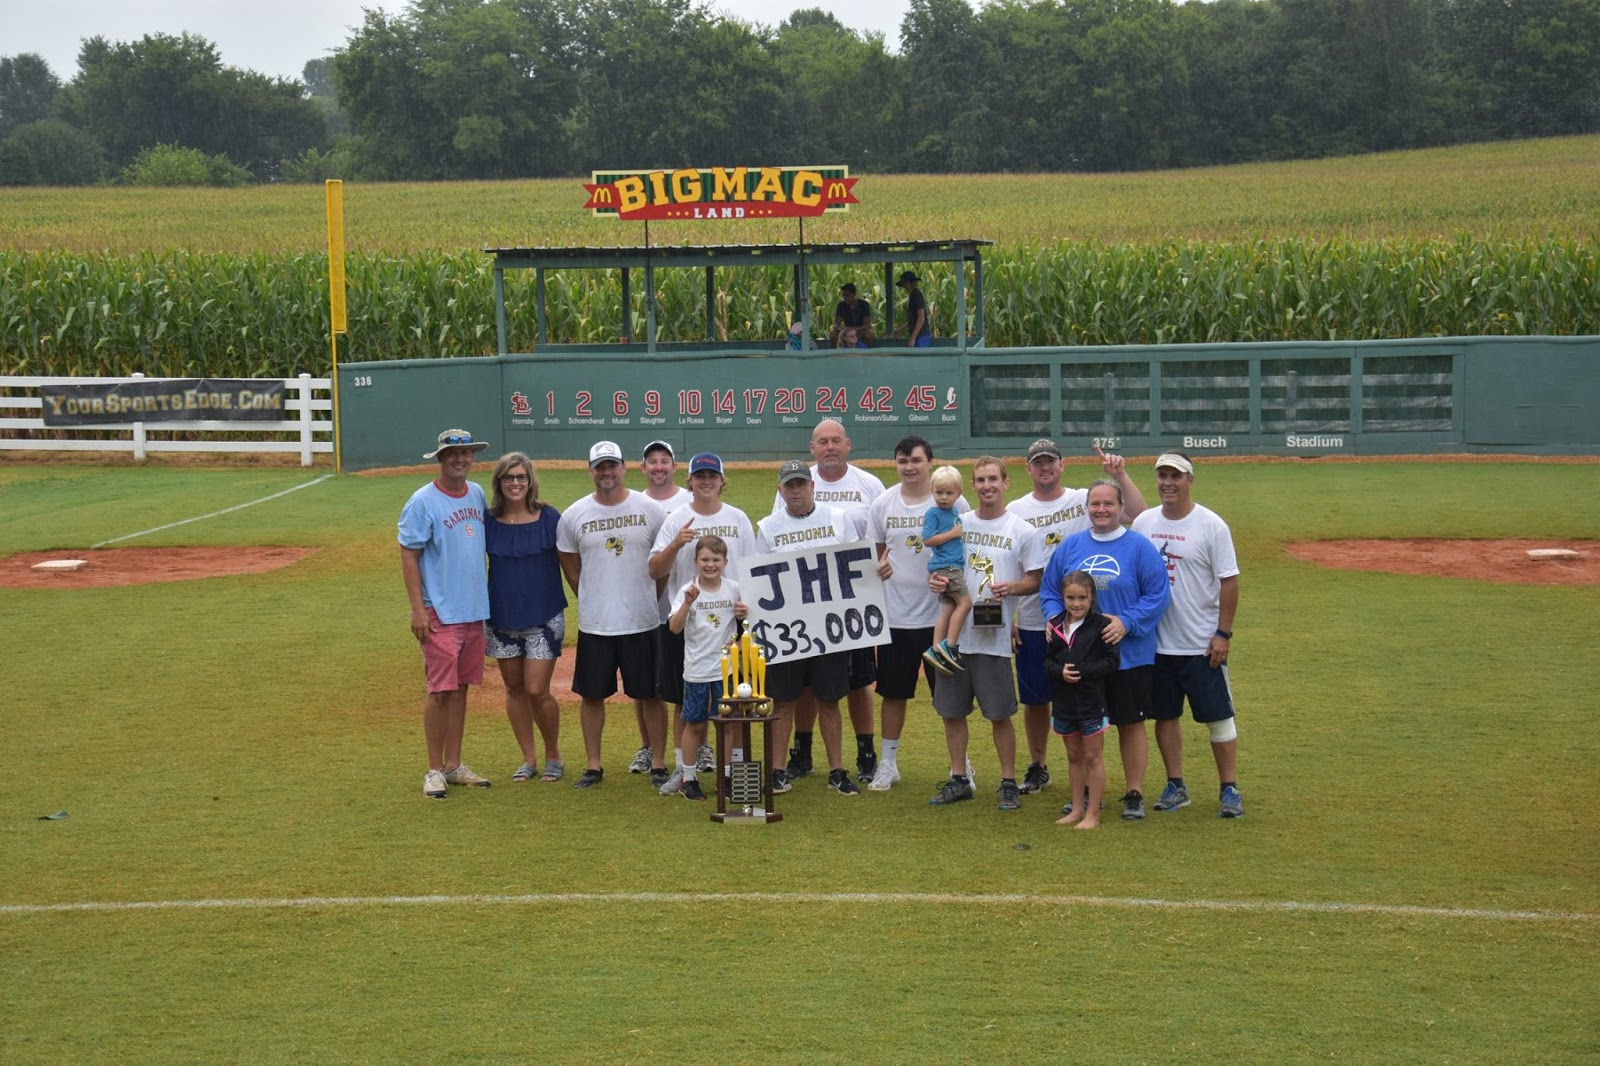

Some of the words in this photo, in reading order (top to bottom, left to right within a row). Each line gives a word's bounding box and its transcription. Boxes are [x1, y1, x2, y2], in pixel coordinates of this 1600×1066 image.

[614, 168, 702, 213] BIG
[712, 166, 824, 207] MAC
[694, 207, 745, 218] LAND
[354, 376, 372, 386] 336
[546, 391, 555, 415] 1
[576, 391, 592, 416] 2
[613, 391, 629, 416] 6
[645, 390, 661, 416] 9
[678, 390, 701, 415] 10
[712, 389, 735, 415] 14
[743, 388, 768, 414] 17
[775, 387, 806, 414] 20
[815, 386, 848, 412] 24
[859, 386, 893, 412] 42
[904, 385, 936, 411] 45
[512, 417, 536, 426] Hornsby
[544, 417, 560, 425] Smith
[568, 417, 605, 425] Schoendienst
[612, 417, 630, 425] Musial
[640, 416, 666, 425] Slaughter
[678, 417, 686, 425] La
[687, 417, 704, 425] Russa
[716, 416, 733, 426] Boyer
[746, 417, 762, 425] Dean
[855, 414, 899, 422] Robinson/Sutter
[909, 414, 929, 422] Gibson
[941, 414, 957, 422] Buck
[1183, 436, 1226, 448] Busch
[1286, 435, 1343, 448] Stadium
[814, 491, 862, 502] EDONIA
[581, 514, 647, 534] FREDONIA
[886, 516, 924, 529] FREDO
[694, 525, 739, 539] EDONIA
[774, 525, 835, 547] FREDONIA
[962, 531, 1012, 551] REDONIA
[750, 547, 872, 611] JHF
[696, 599, 733, 610] FREDONIA
[751, 604, 884, 662] $33,000
